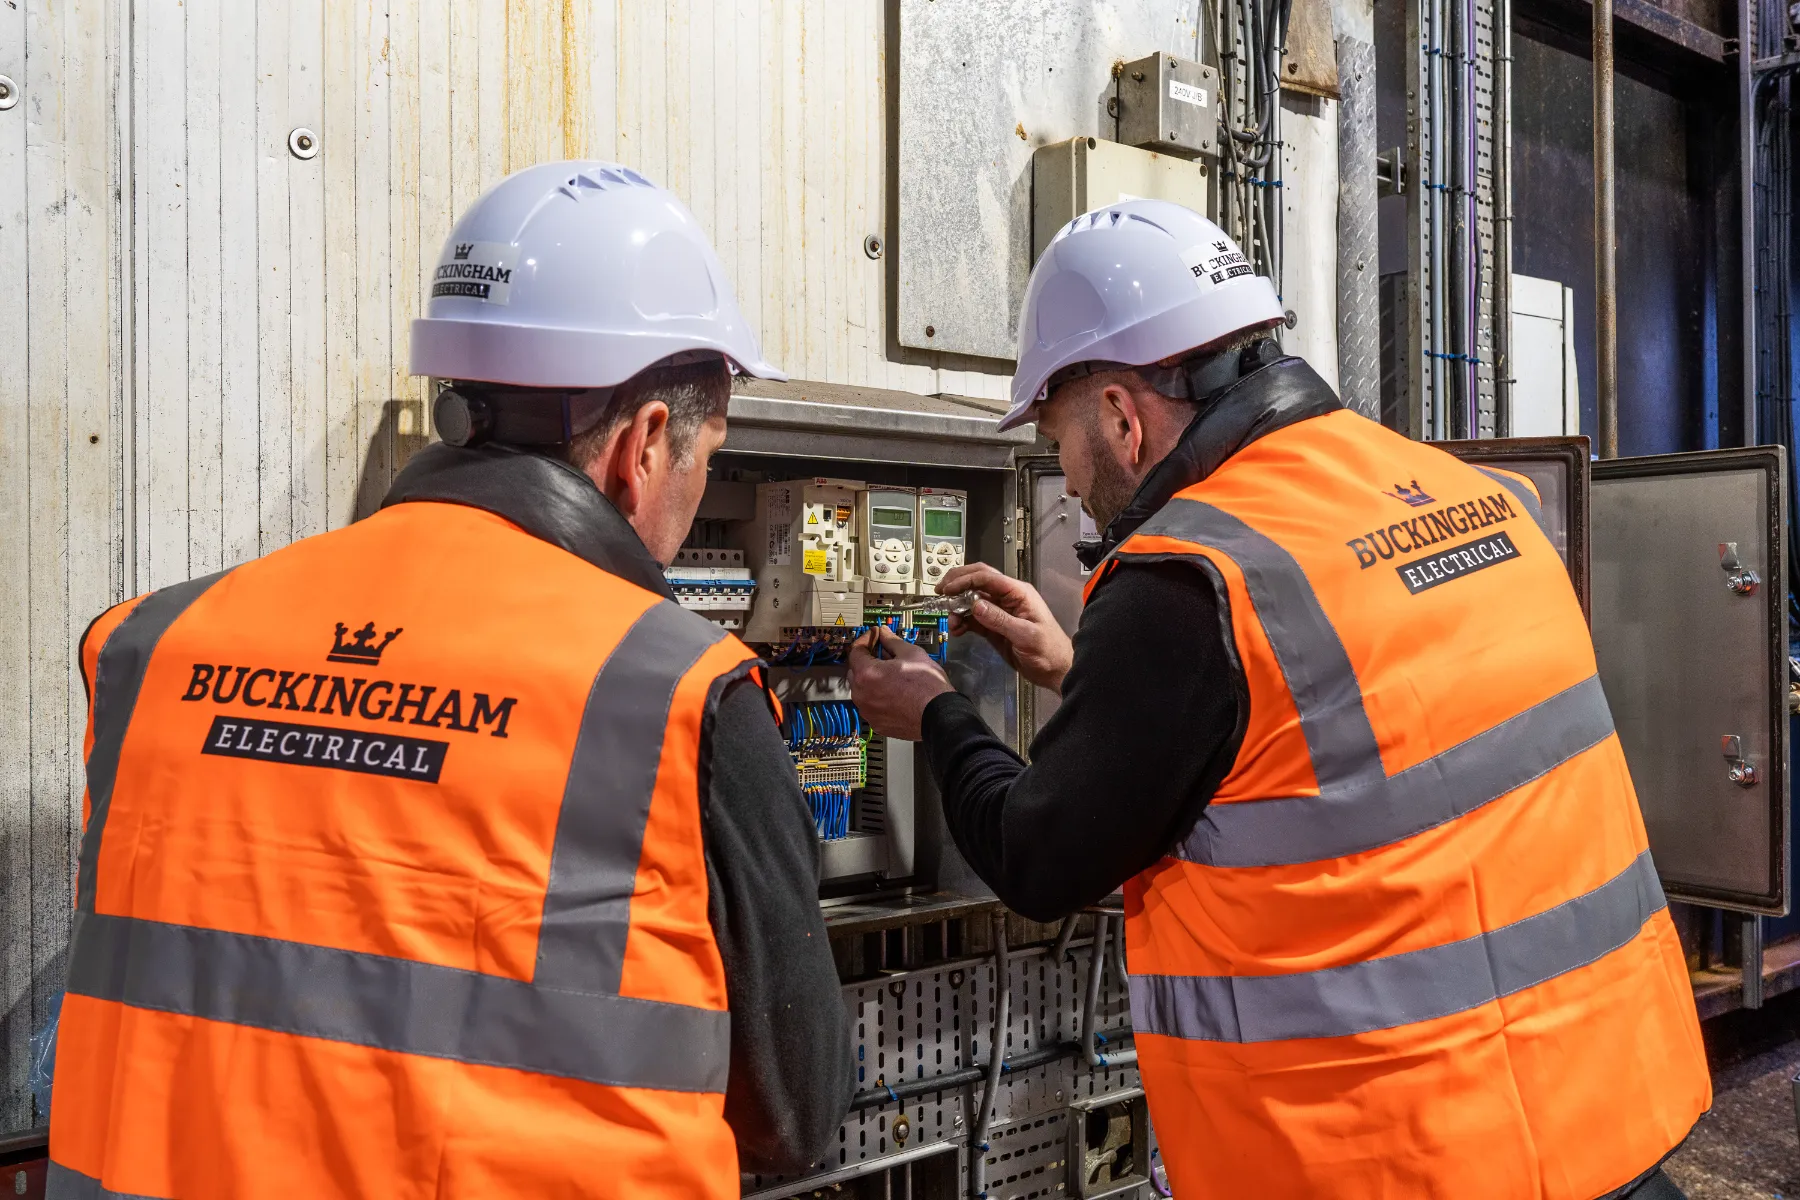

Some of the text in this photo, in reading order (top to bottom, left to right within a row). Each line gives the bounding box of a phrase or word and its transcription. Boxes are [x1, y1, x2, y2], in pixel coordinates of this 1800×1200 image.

[1174, 86, 1191, 98] 240V
[434, 263, 512, 283] UCKINGHAM
[1345, 493, 1518, 570] BUCKINGHAM
[1405, 538, 1514, 588] ELECTRICAL
[181, 663, 518, 738] BUCKINGHAM
[215, 724, 430, 774] ELECTRICAL
